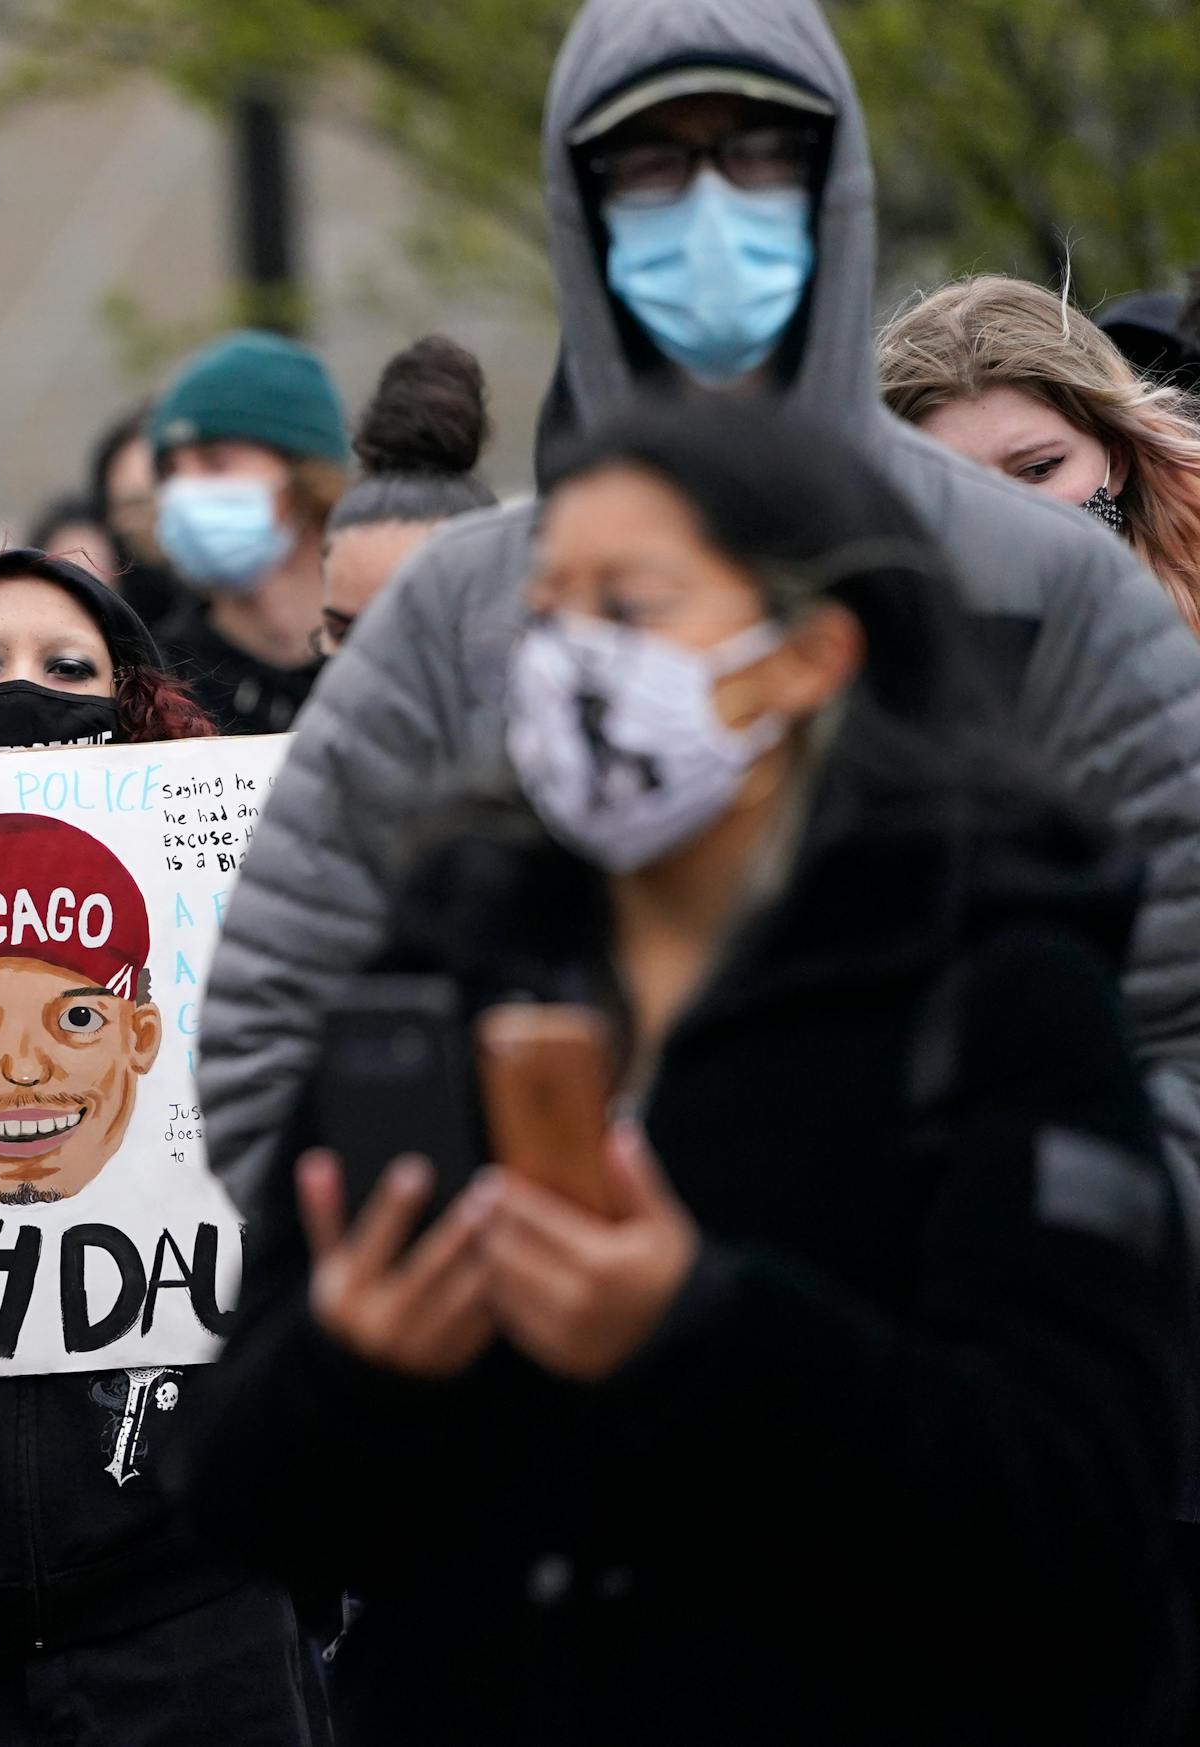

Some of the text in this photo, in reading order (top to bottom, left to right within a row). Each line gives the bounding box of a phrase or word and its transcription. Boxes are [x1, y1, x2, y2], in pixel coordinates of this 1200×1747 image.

[15, 764, 163, 811] POLICE
[162, 777, 224, 799] Saying
[235, 773, 256, 790] he
[164, 804, 259, 824] he had an
[164, 1123, 202, 1141] does
